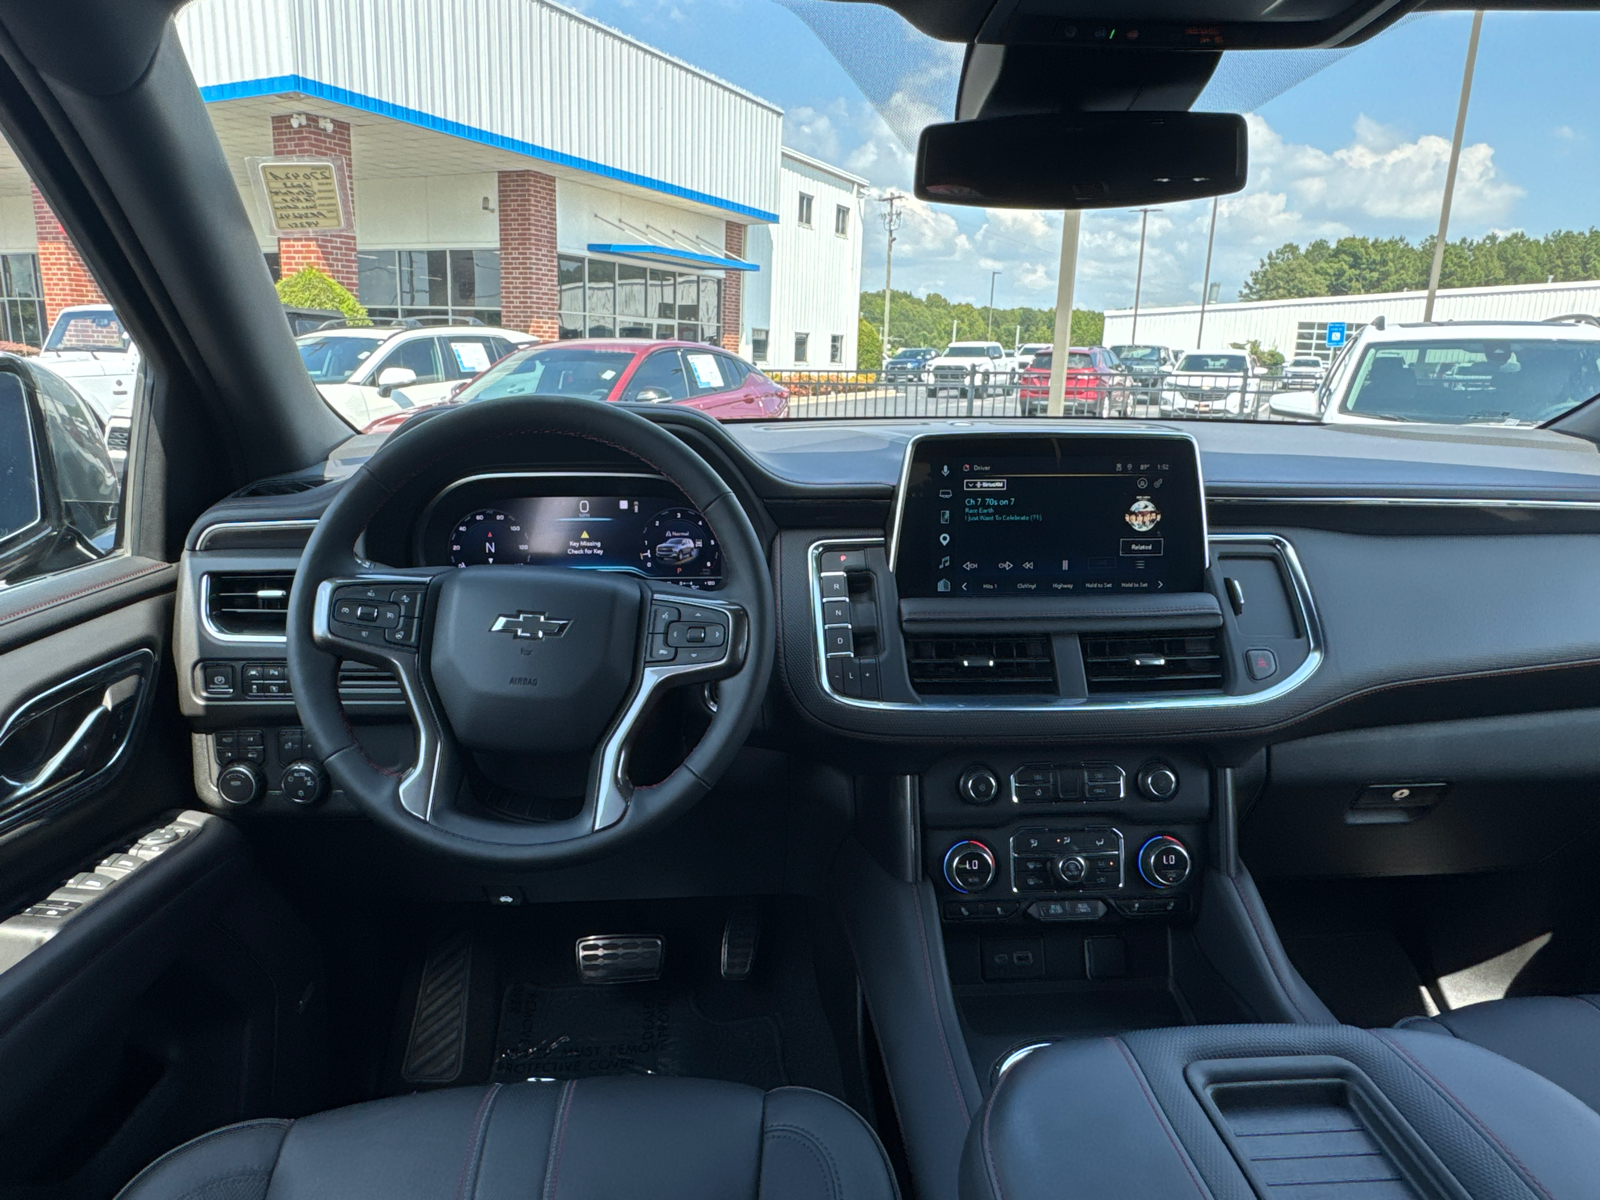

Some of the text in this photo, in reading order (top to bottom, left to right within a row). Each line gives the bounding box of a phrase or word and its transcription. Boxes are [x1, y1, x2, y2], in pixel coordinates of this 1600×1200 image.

[486, 542, 495, 553] N
[509, 676, 538, 686] AIRBAG
[967, 860, 979, 869] LO
[1163, 855, 1175, 864] LO
[496, 1060, 581, 1074] PROTECTIVE
